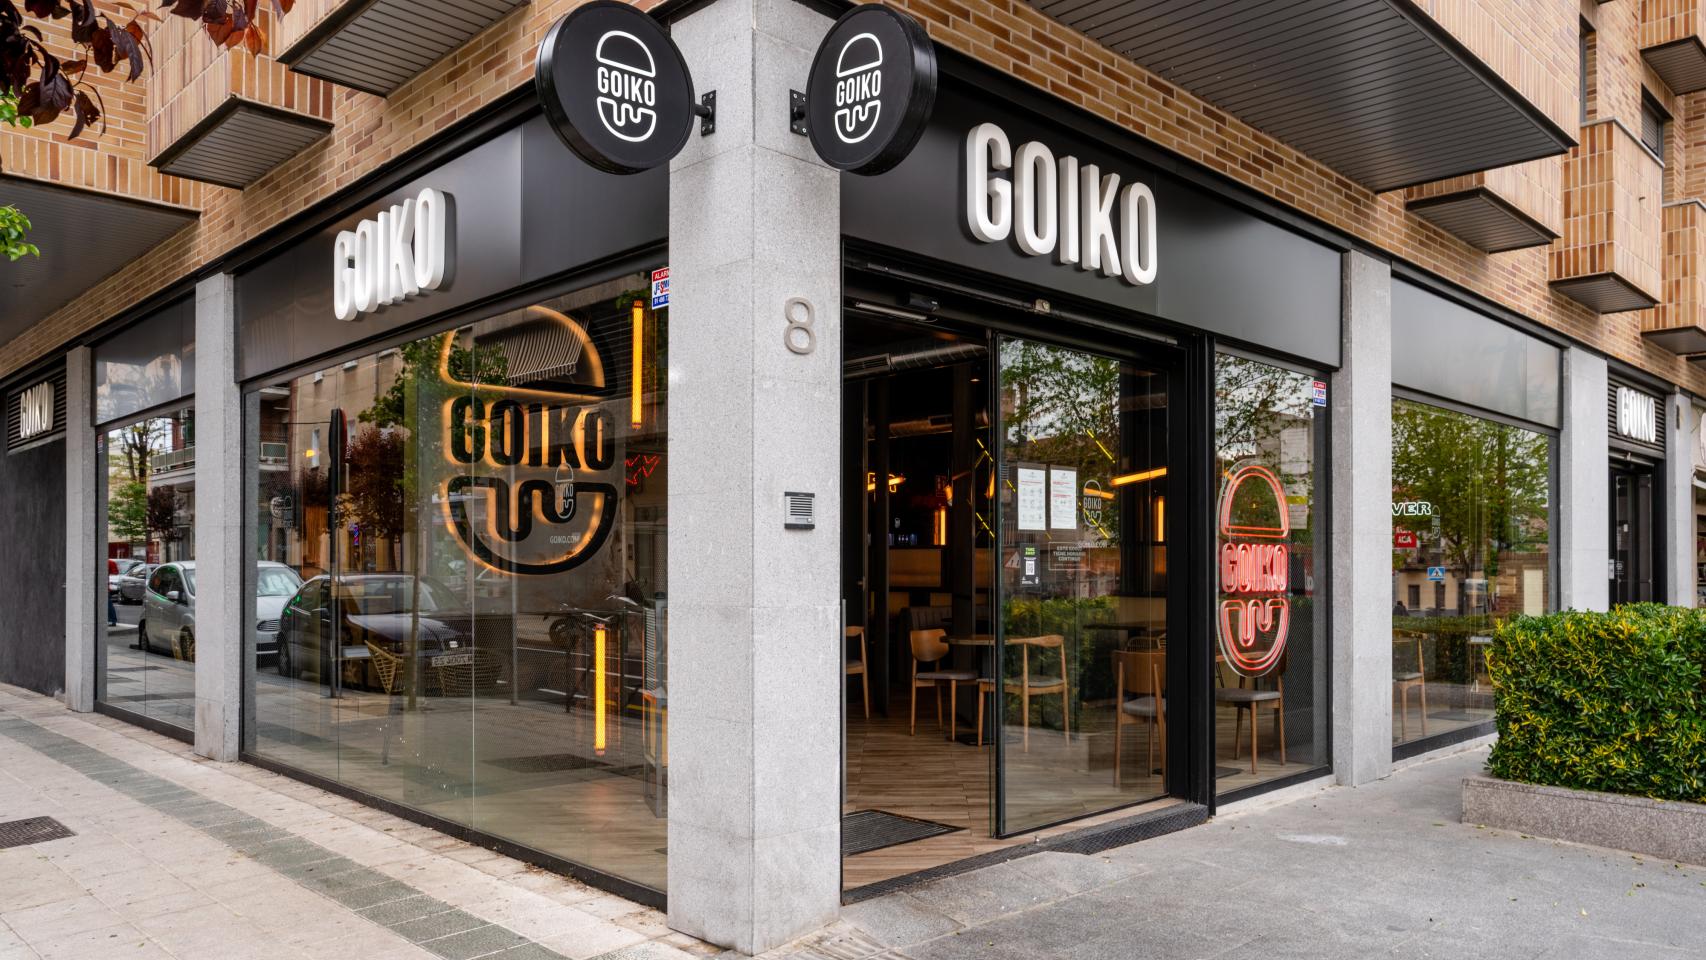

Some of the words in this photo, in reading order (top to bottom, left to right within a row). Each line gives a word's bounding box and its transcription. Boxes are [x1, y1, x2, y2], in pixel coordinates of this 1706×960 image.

[597, 66, 656, 107] GOIKO
[836, 69, 881, 107] GOIKO
[966, 122, 1157, 286] GOIKO
[333, 187, 446, 321] GOIKO
[784, 296, 817, 355] 8
[20, 381, 54, 438] GOIKO
[450, 395, 616, 471] GOIKO
[1617, 386, 1656, 443] GOIKO
[1083, 497, 1101, 509] GOIKO
[1221, 542, 1288, 592] GOIKO
